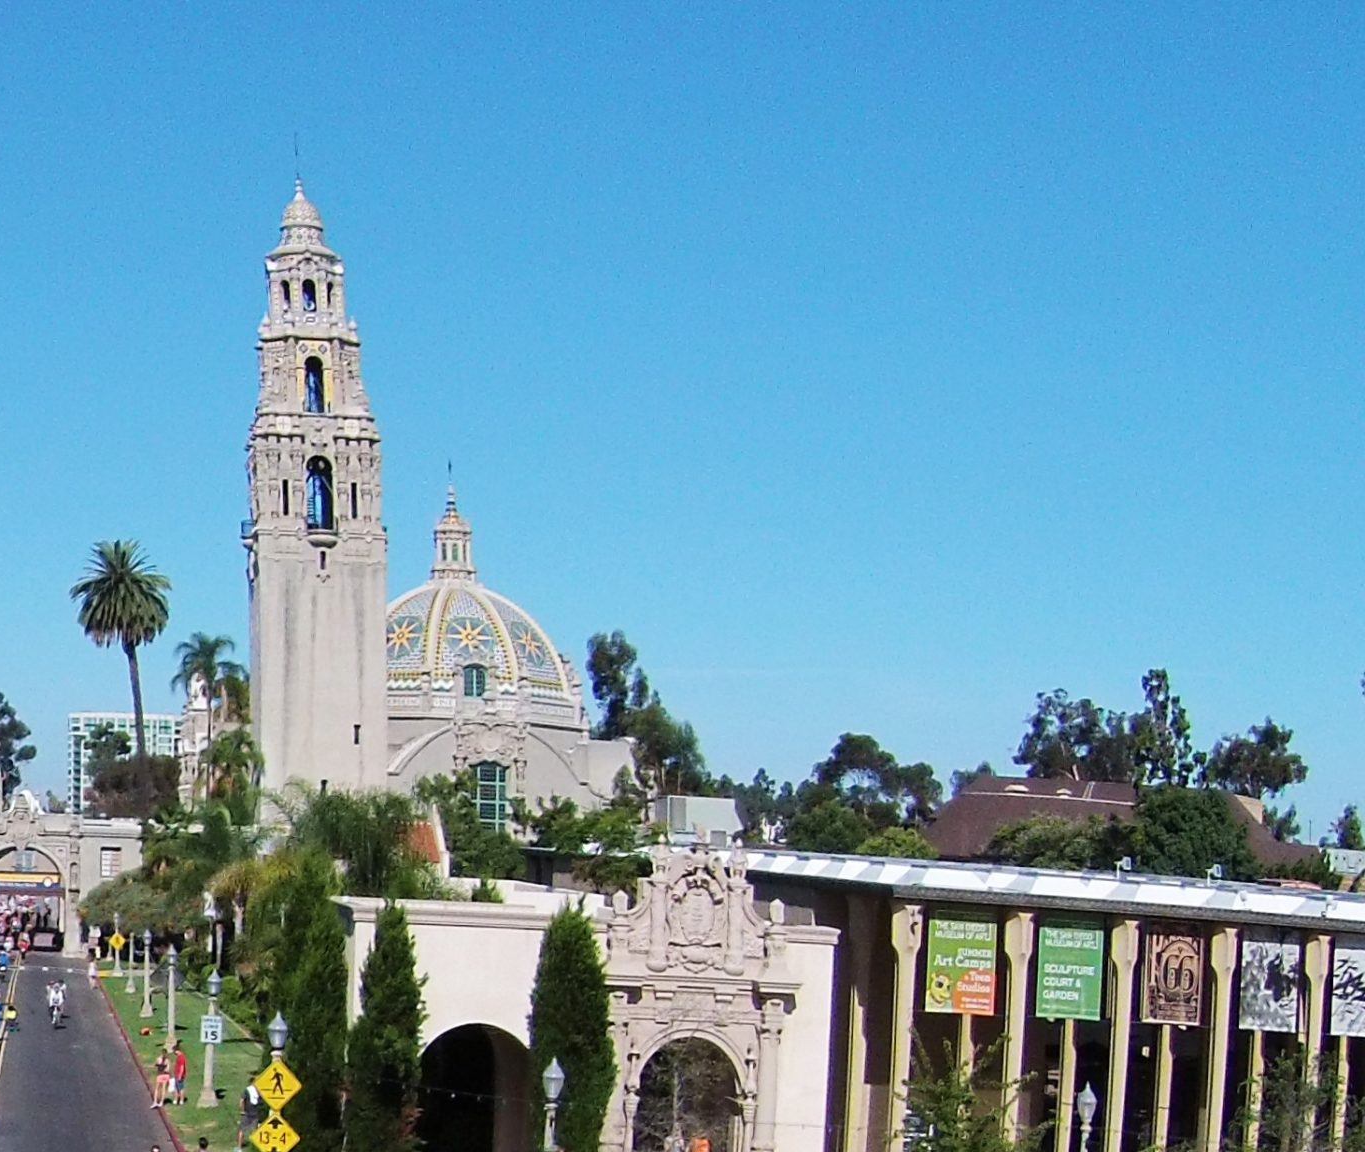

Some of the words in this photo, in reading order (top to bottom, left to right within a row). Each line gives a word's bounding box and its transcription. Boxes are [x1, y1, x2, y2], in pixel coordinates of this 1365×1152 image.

[934, 954, 953, 966] Art
[955, 956, 991, 970] Camps
[1044, 963, 1095, 976] SCULPTURE
[1043, 977, 1073, 988] COURT
[1042, 989, 1079, 1000] GARDEN
[205, 1030, 218, 1041] 15
